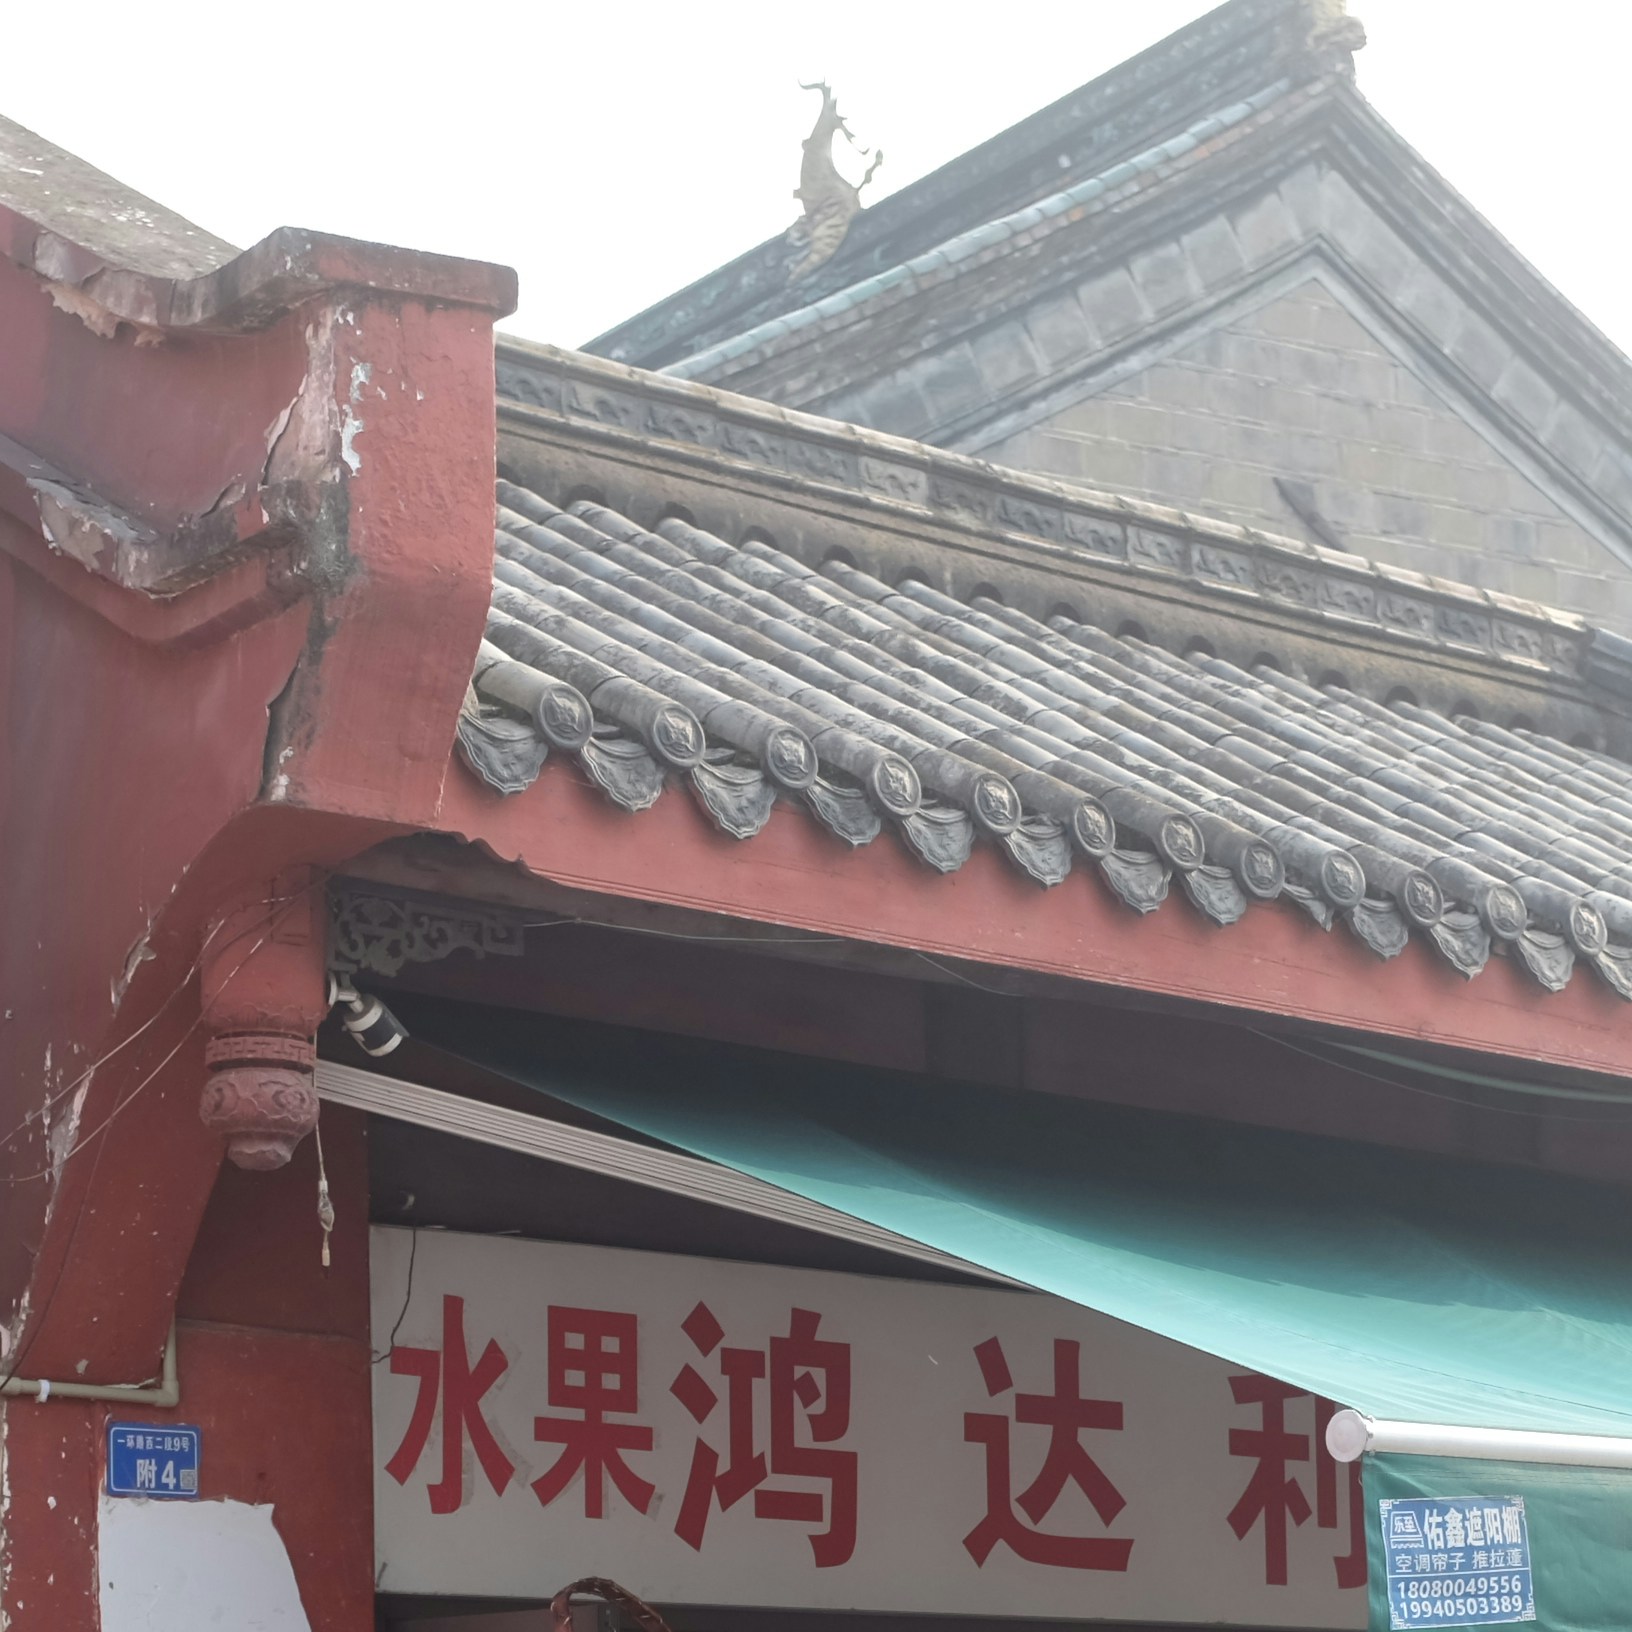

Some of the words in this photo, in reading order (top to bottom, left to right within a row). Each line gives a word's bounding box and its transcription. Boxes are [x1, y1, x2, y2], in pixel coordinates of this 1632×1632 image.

[117, 1434, 191, 1453] 一环路西二段9号
[1423, 1505, 1522, 1550] 佑鑫遮阳棚
[1394, 1551, 1466, 1574] 空调帘子
[1397, 1574, 1522, 1600] 18080049556
[1399, 1595, 1523, 1620] 19940503389
